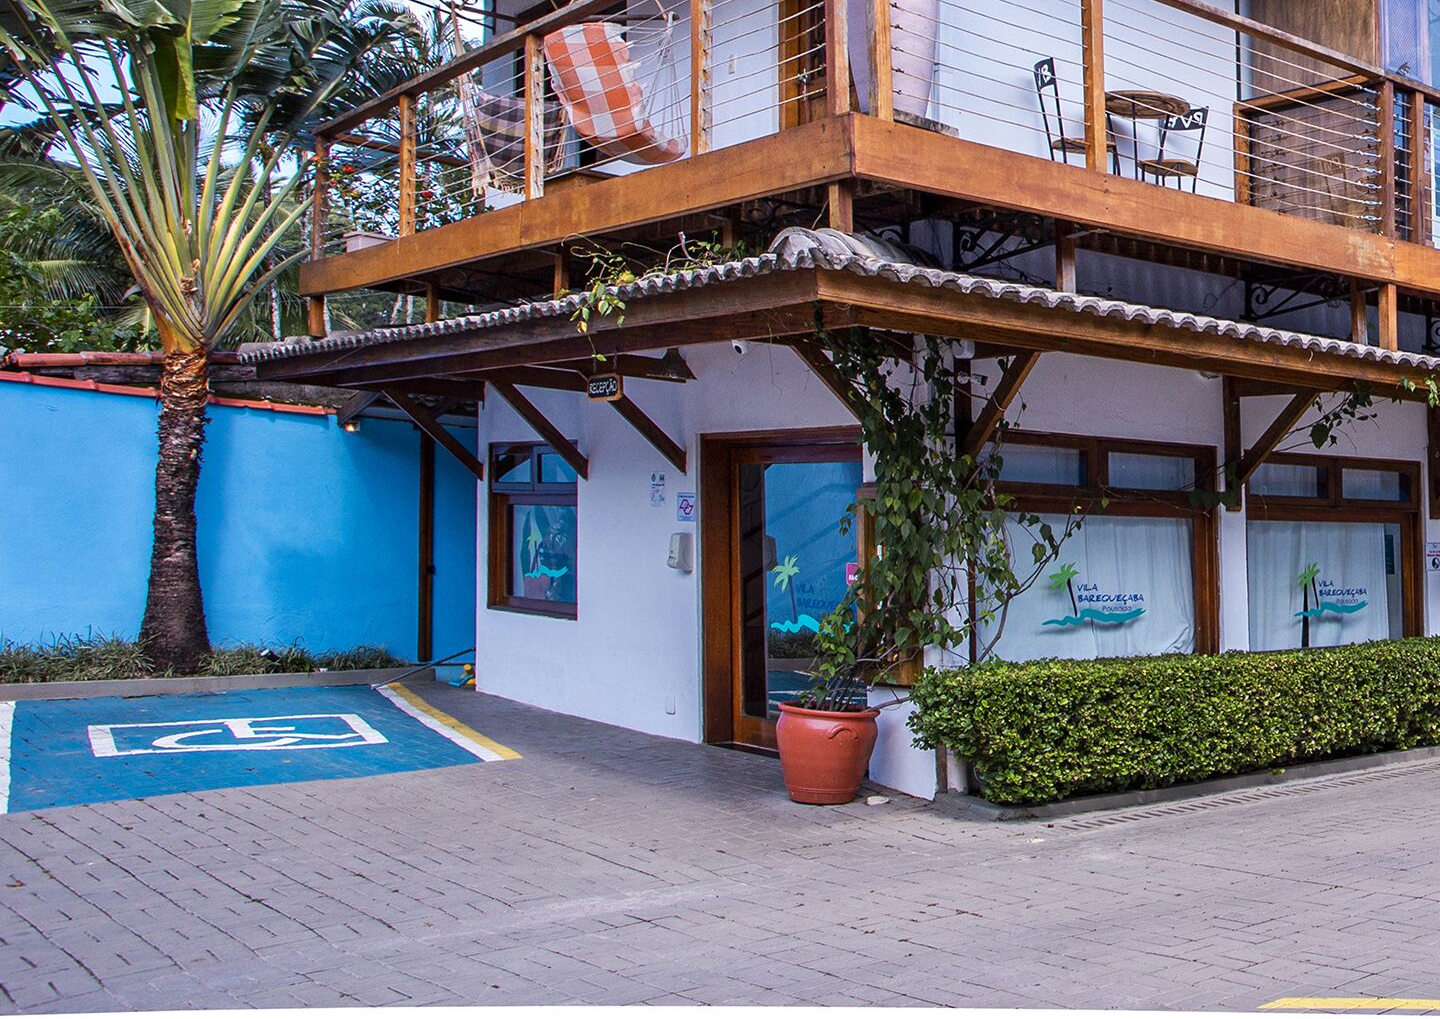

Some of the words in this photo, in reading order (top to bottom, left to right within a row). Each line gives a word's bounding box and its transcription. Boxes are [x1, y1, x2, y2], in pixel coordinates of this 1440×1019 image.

[590, 378, 616, 395] RECEPÇÃO
[1076, 583, 1099, 592] VILA
[1317, 580, 1335, 588] VILA
[1318, 588, 1368, 599] BAREQUEÇABA
[1076, 593, 1145, 606] BAREQUEÇABA
